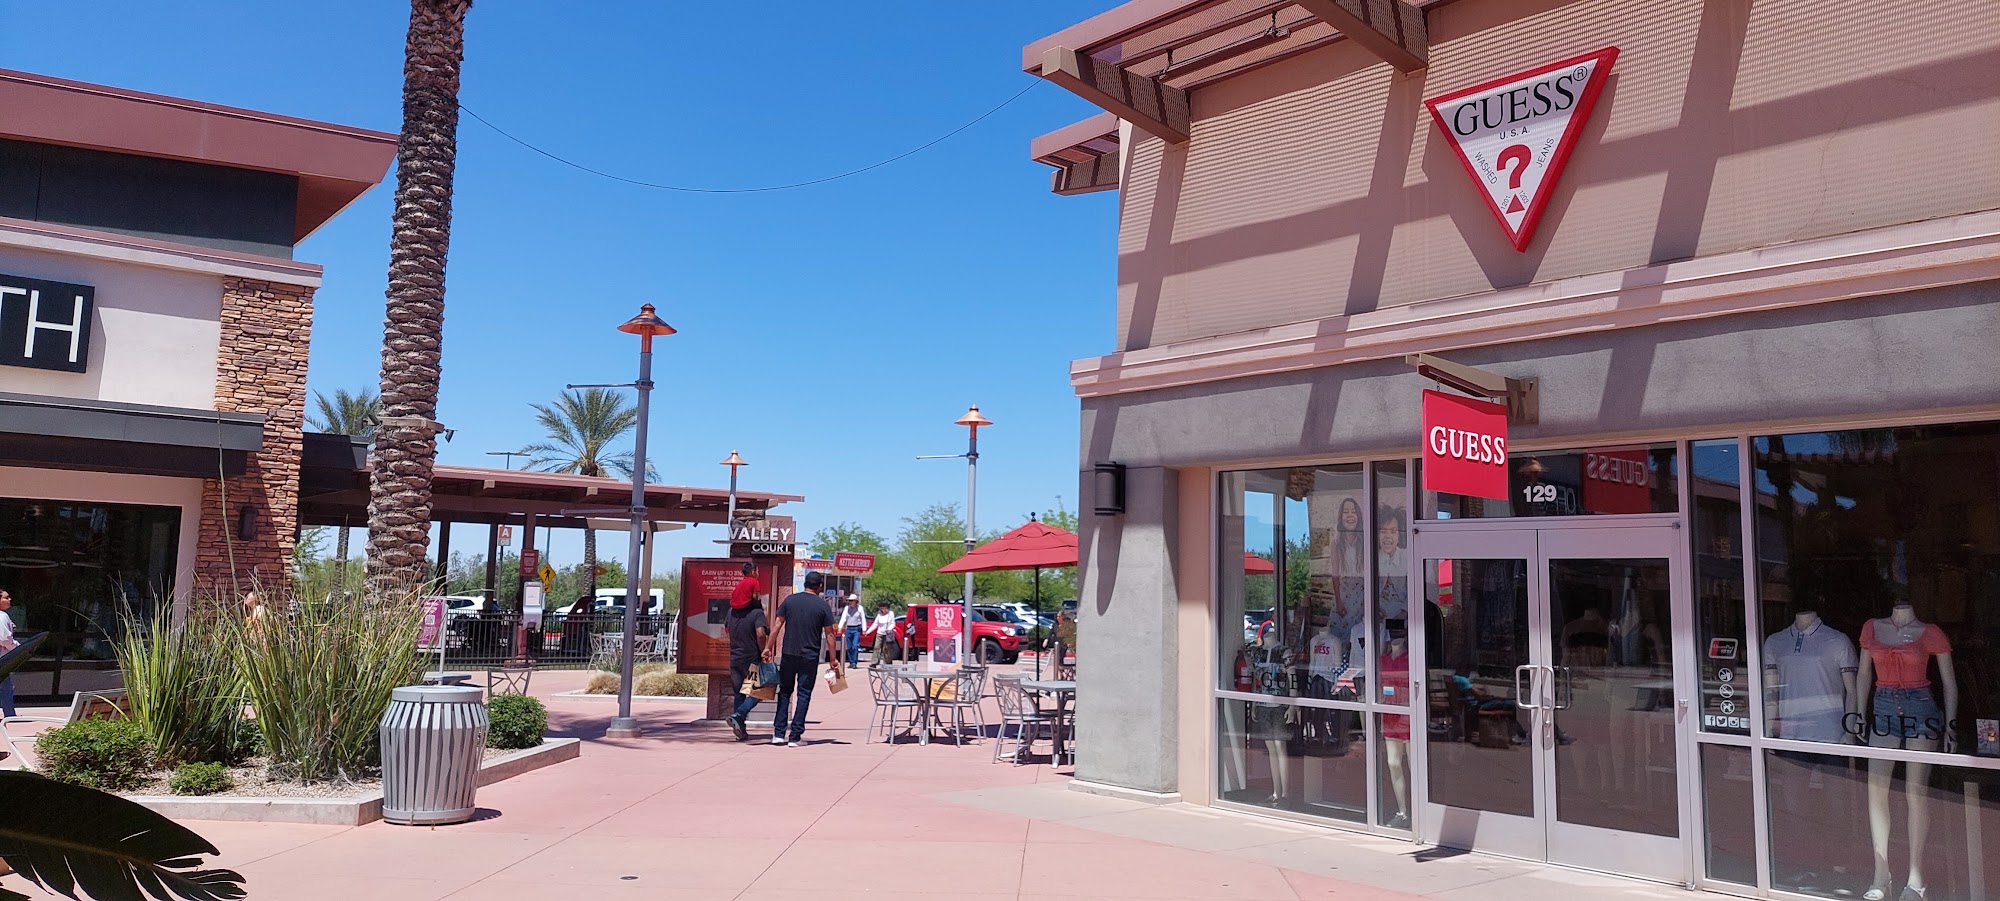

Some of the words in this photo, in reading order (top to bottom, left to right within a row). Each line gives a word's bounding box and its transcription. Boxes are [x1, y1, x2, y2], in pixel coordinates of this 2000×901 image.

[1453, 75, 1574, 136] GUESS
[1536, 138, 1555, 168] JEANS
[1474, 151, 1498, 185] WASHED
[1429, 425, 1505, 466] GUESS
[1522, 484, 1557, 503] 129
[501, 527, 510, 538] A
[728, 527, 791, 541] VALLEY
[752, 543, 790, 553] COURT
[934, 607, 954, 620] $150
[936, 620, 953, 628] BACK
